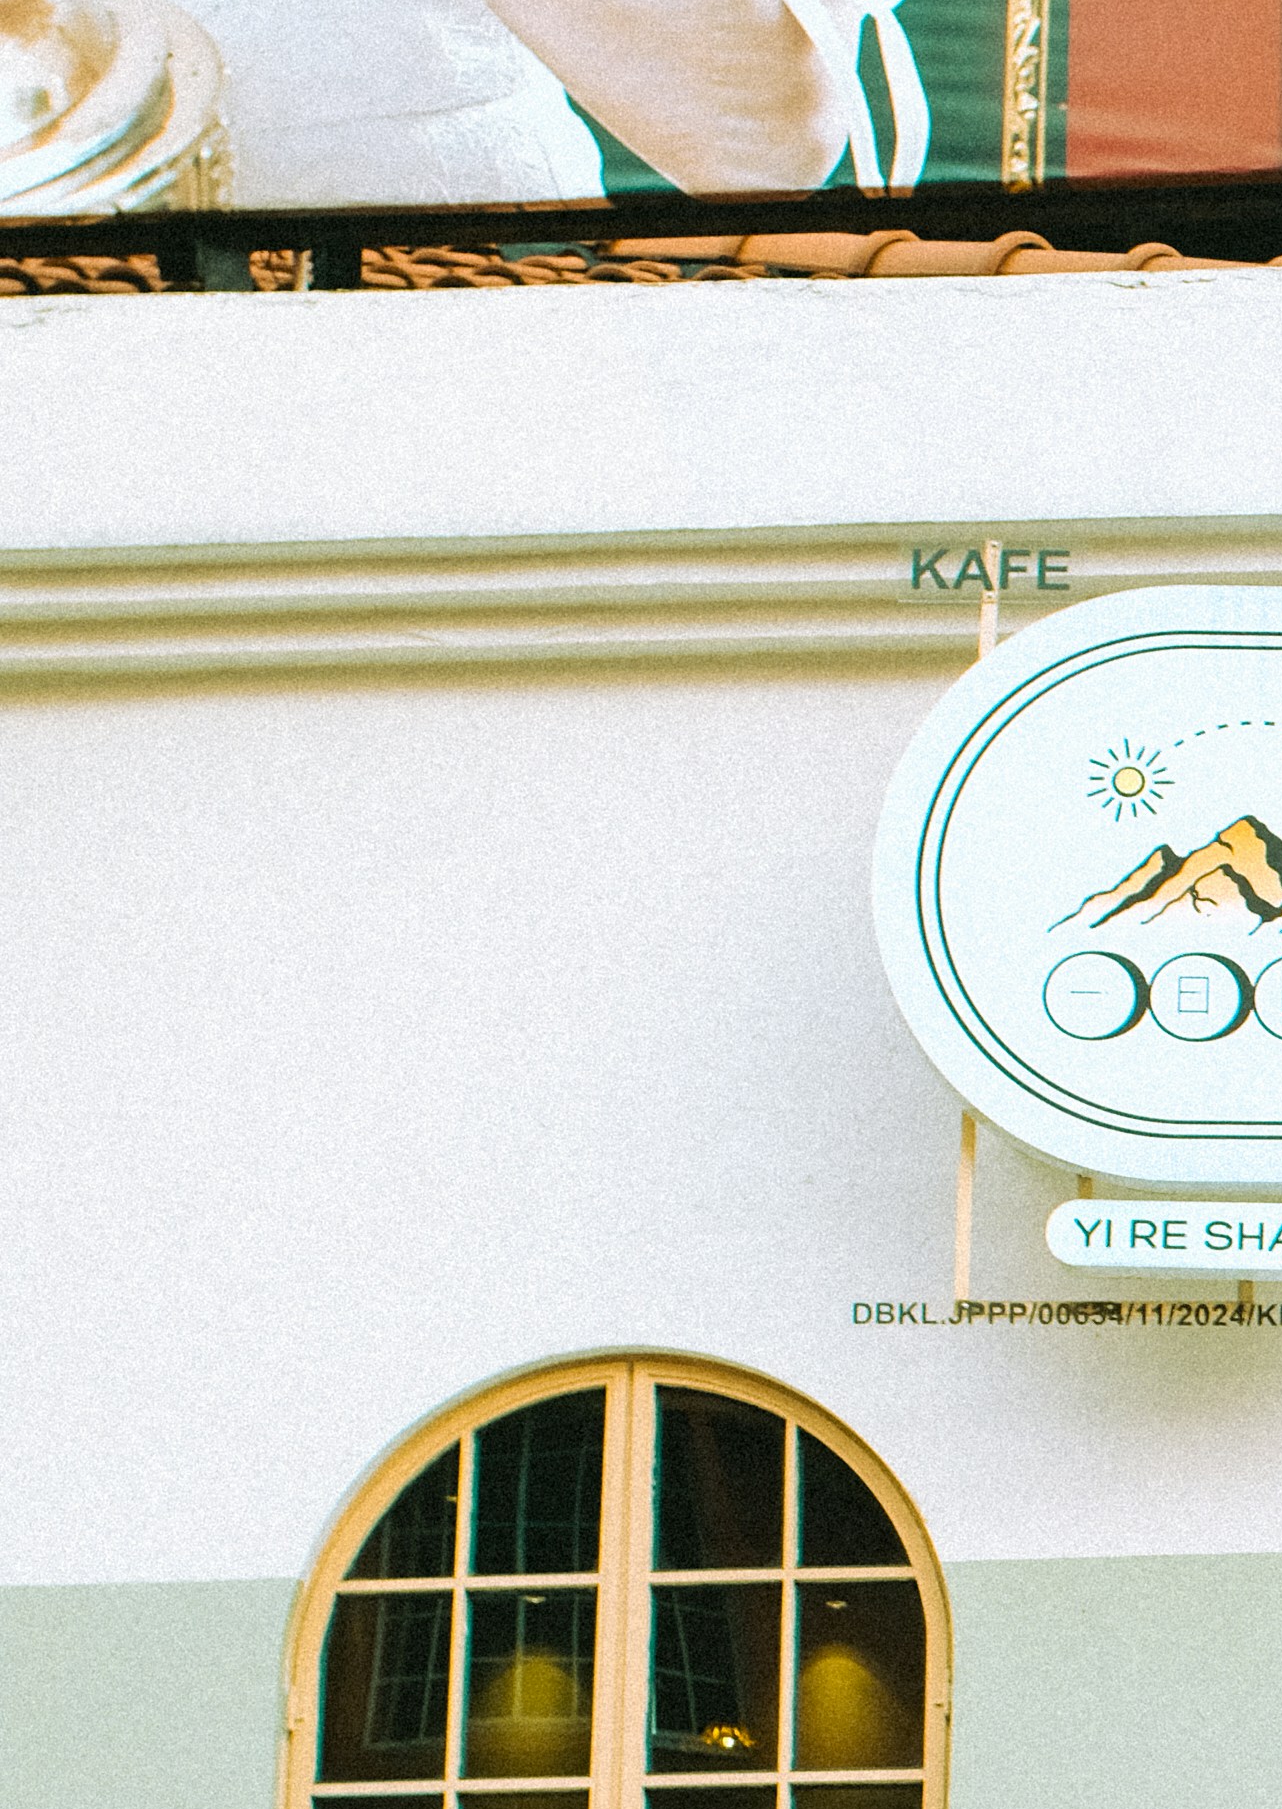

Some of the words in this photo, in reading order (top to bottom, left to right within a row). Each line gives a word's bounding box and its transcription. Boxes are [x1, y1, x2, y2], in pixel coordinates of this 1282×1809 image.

[910, 548, 1073, 592] KAFE
[1073, 1217, 1112, 1250] YI
[1130, 1219, 1189, 1251] RE
